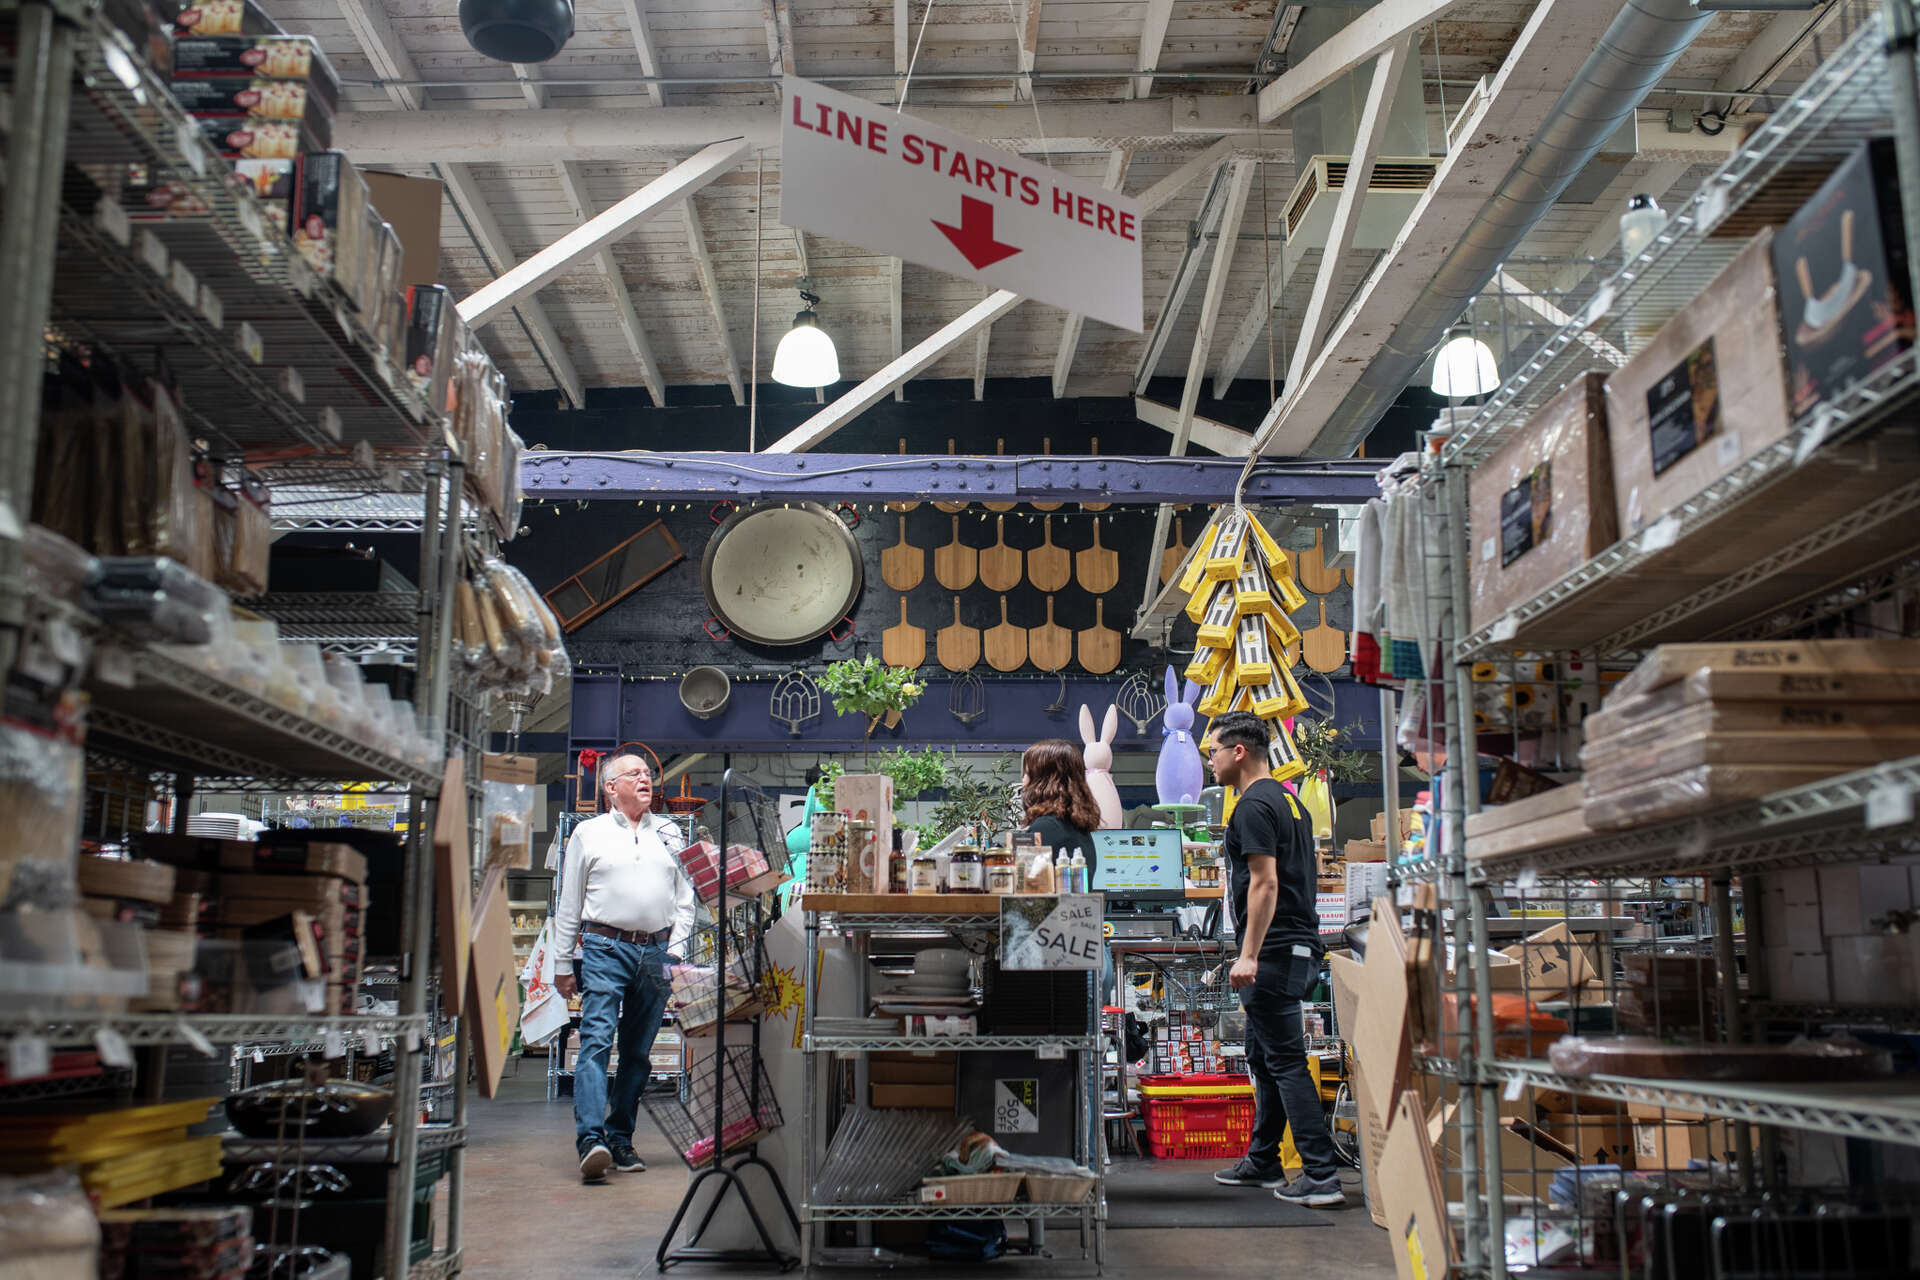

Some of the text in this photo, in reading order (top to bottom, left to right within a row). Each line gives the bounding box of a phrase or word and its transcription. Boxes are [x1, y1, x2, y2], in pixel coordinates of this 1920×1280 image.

[793, 96, 1136, 242] LINE STARTS HERE
[1061, 906, 1093, 921] SALE
[1036, 927, 1099, 960] SALE
[1023, 1080, 1032, 1105] SALE
[997, 1105, 1007, 1131] OFF
[1007, 1099, 1020, 1132] 50%
